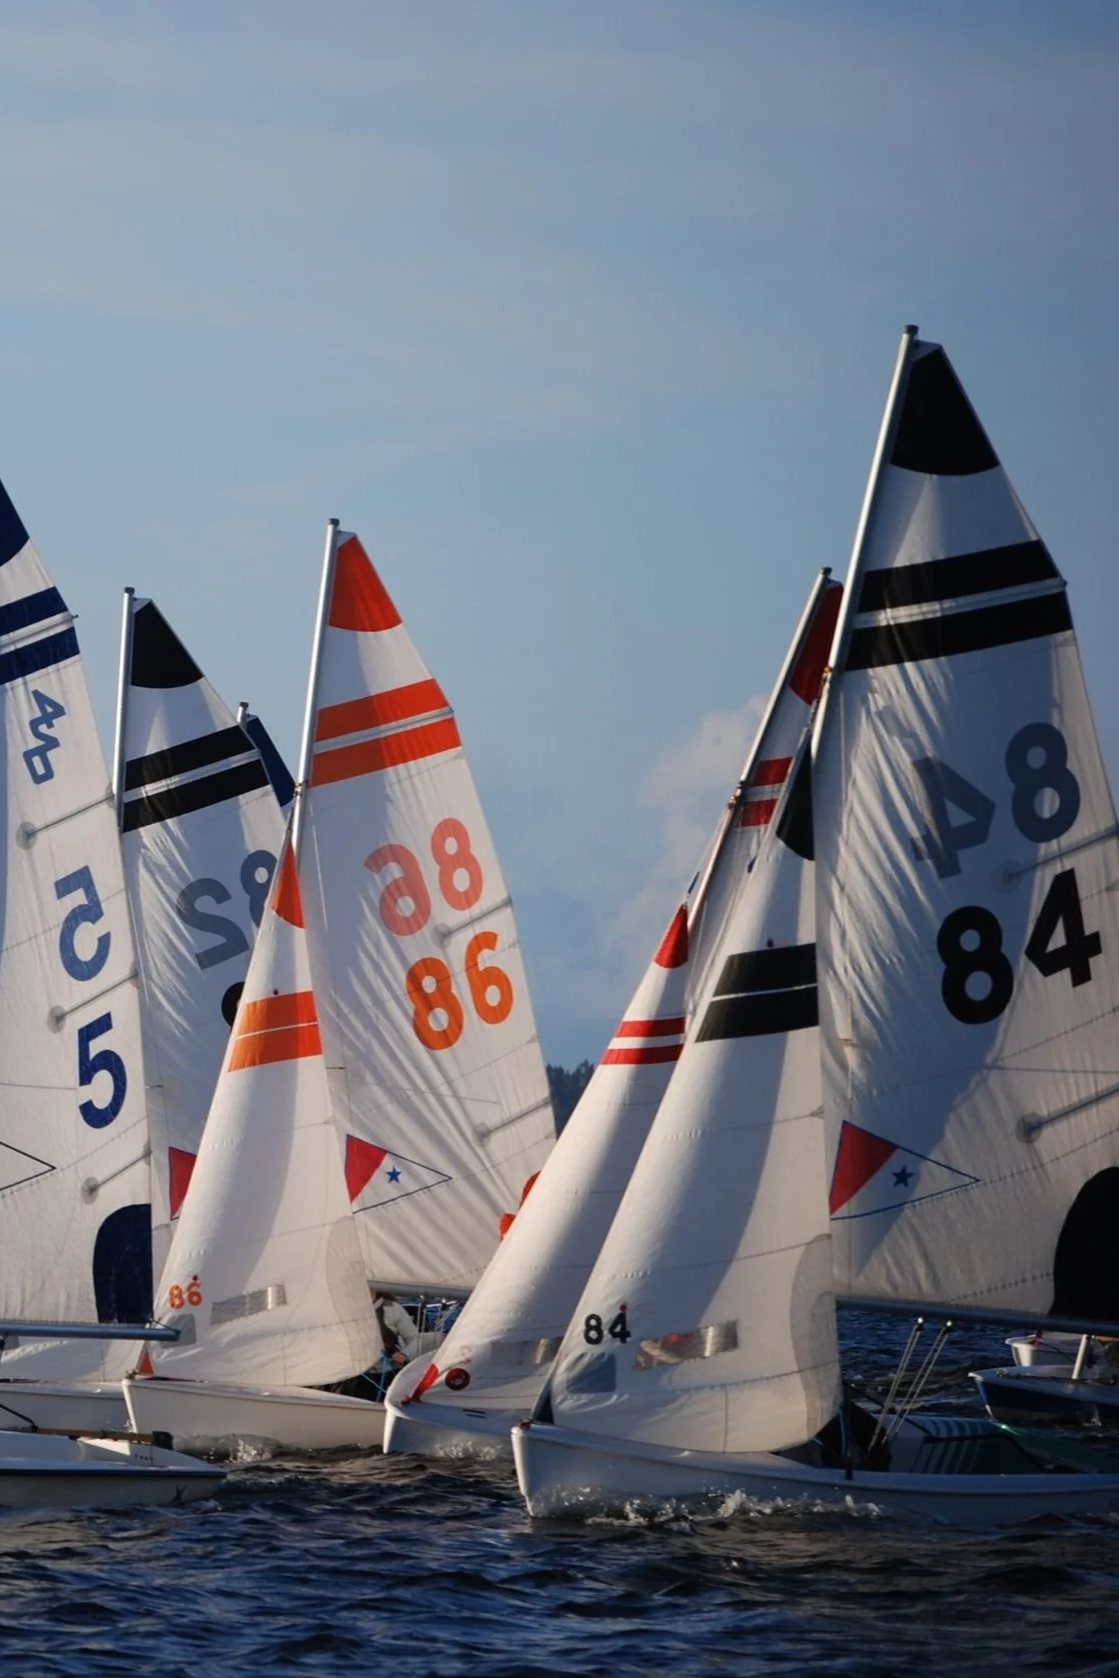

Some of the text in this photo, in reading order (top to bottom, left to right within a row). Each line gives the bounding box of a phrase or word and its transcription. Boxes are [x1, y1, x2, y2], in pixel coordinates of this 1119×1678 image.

[405, 931, 514, 1051] 86
[936, 867, 1102, 1025] 84
[77, 1012, 128, 1128] 5
[169, 1281, 202, 1309] 86
[584, 1312, 631, 1345] 84
